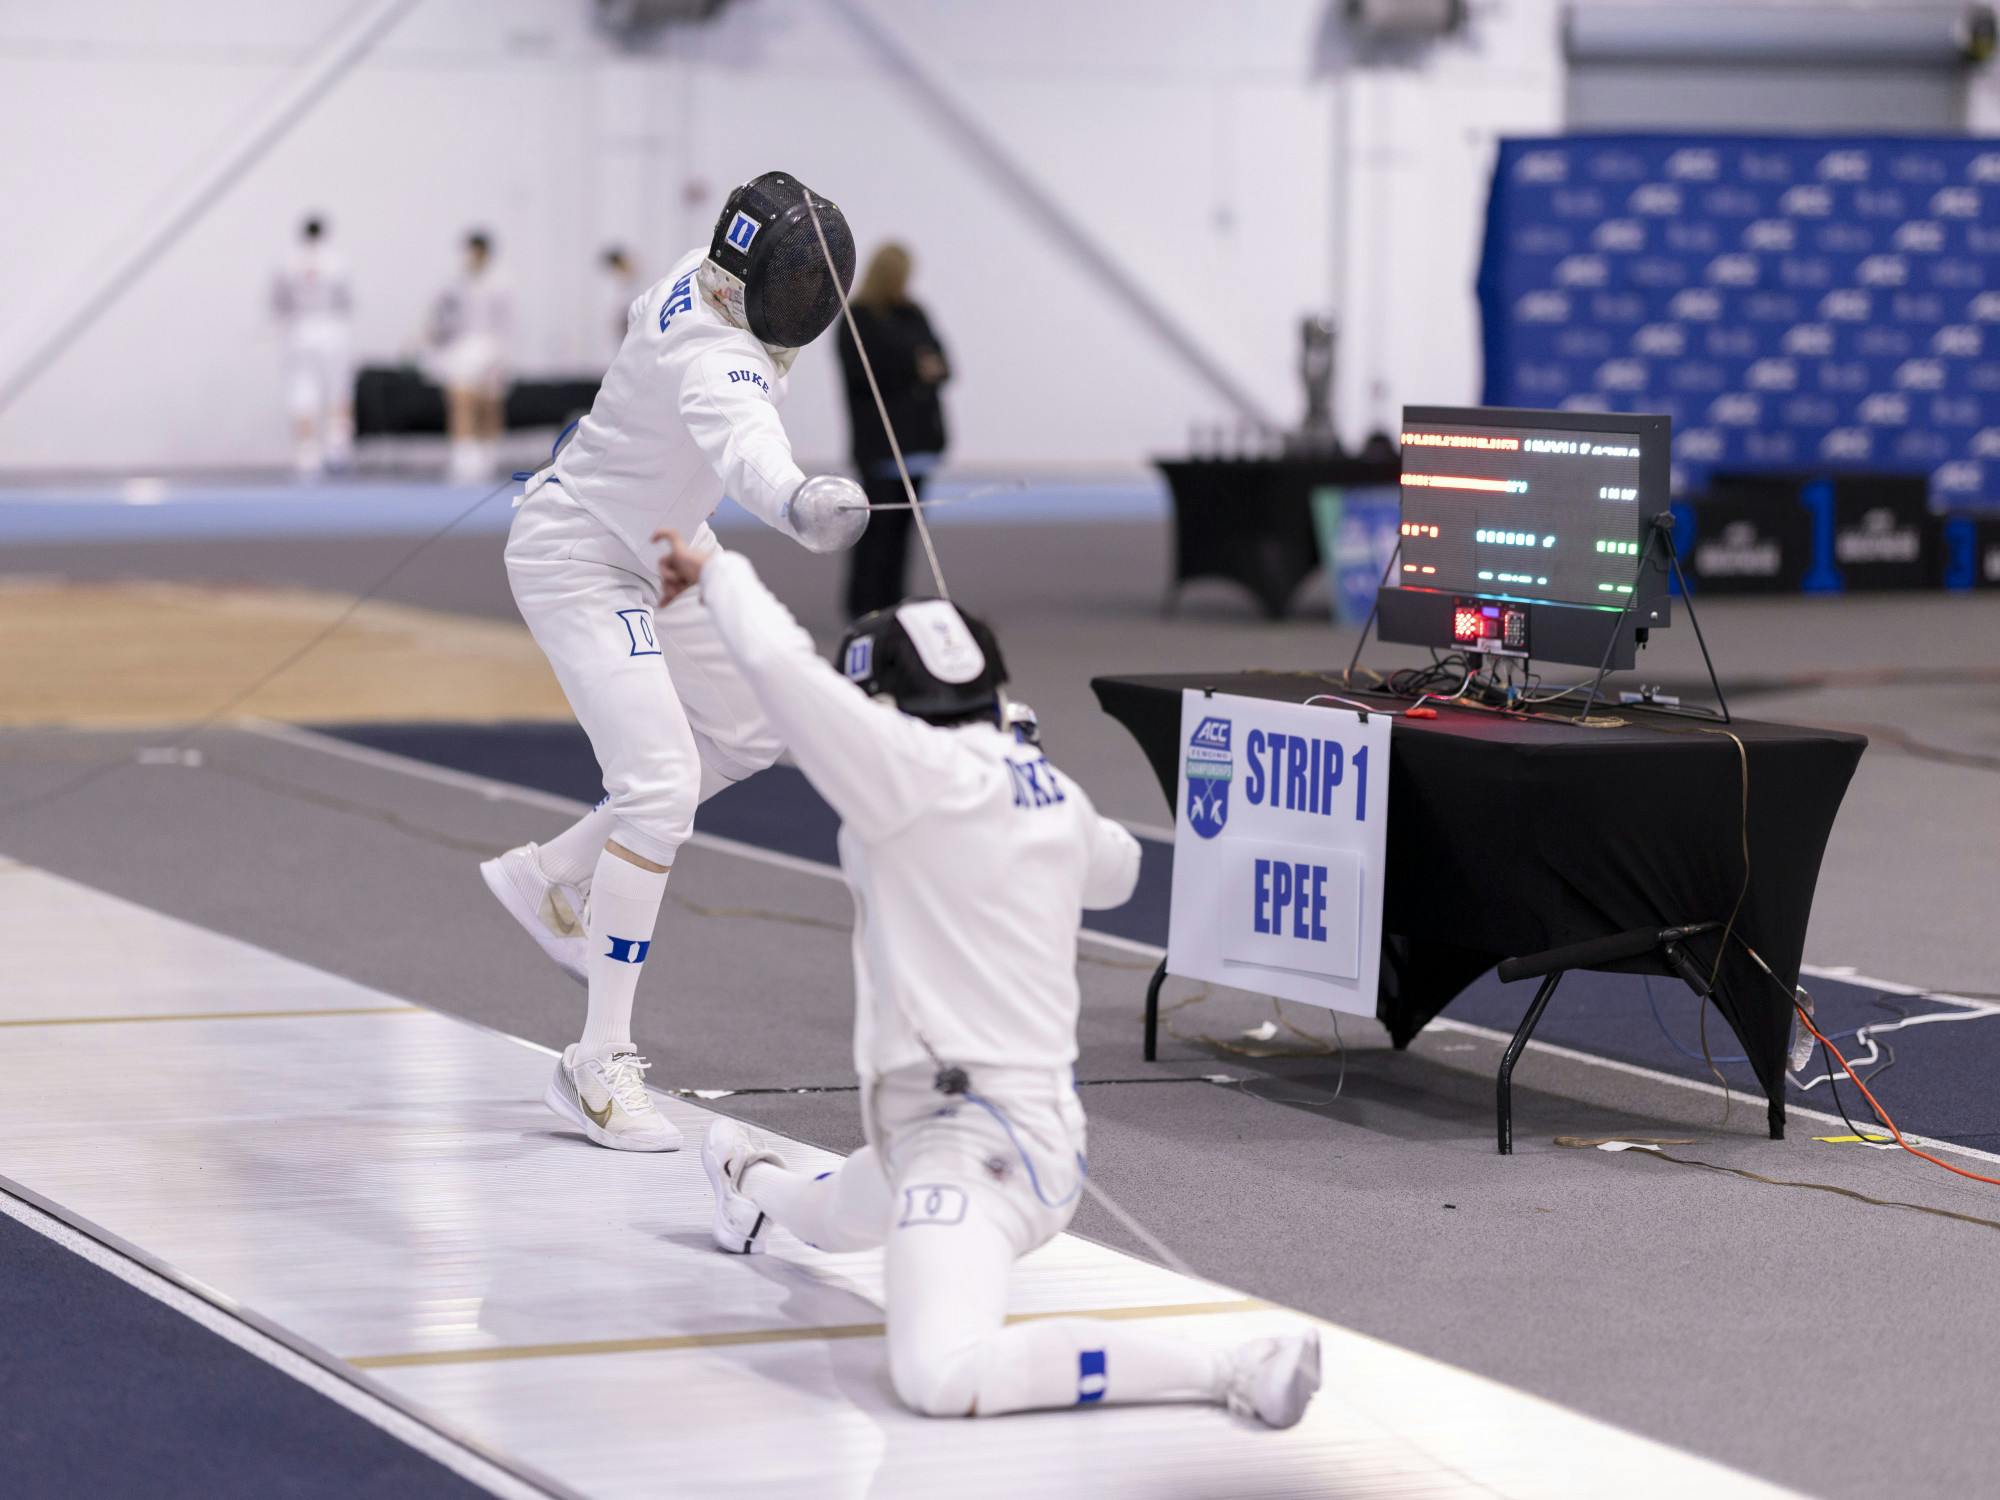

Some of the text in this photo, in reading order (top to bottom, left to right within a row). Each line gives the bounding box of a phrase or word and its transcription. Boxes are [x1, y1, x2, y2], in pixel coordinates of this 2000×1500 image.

[727, 369, 769, 394] DUKE
[1197, 721, 1229, 742] ACC
[1246, 729, 1368, 822] STRIP 1
[1254, 858, 1327, 942] EPEE
